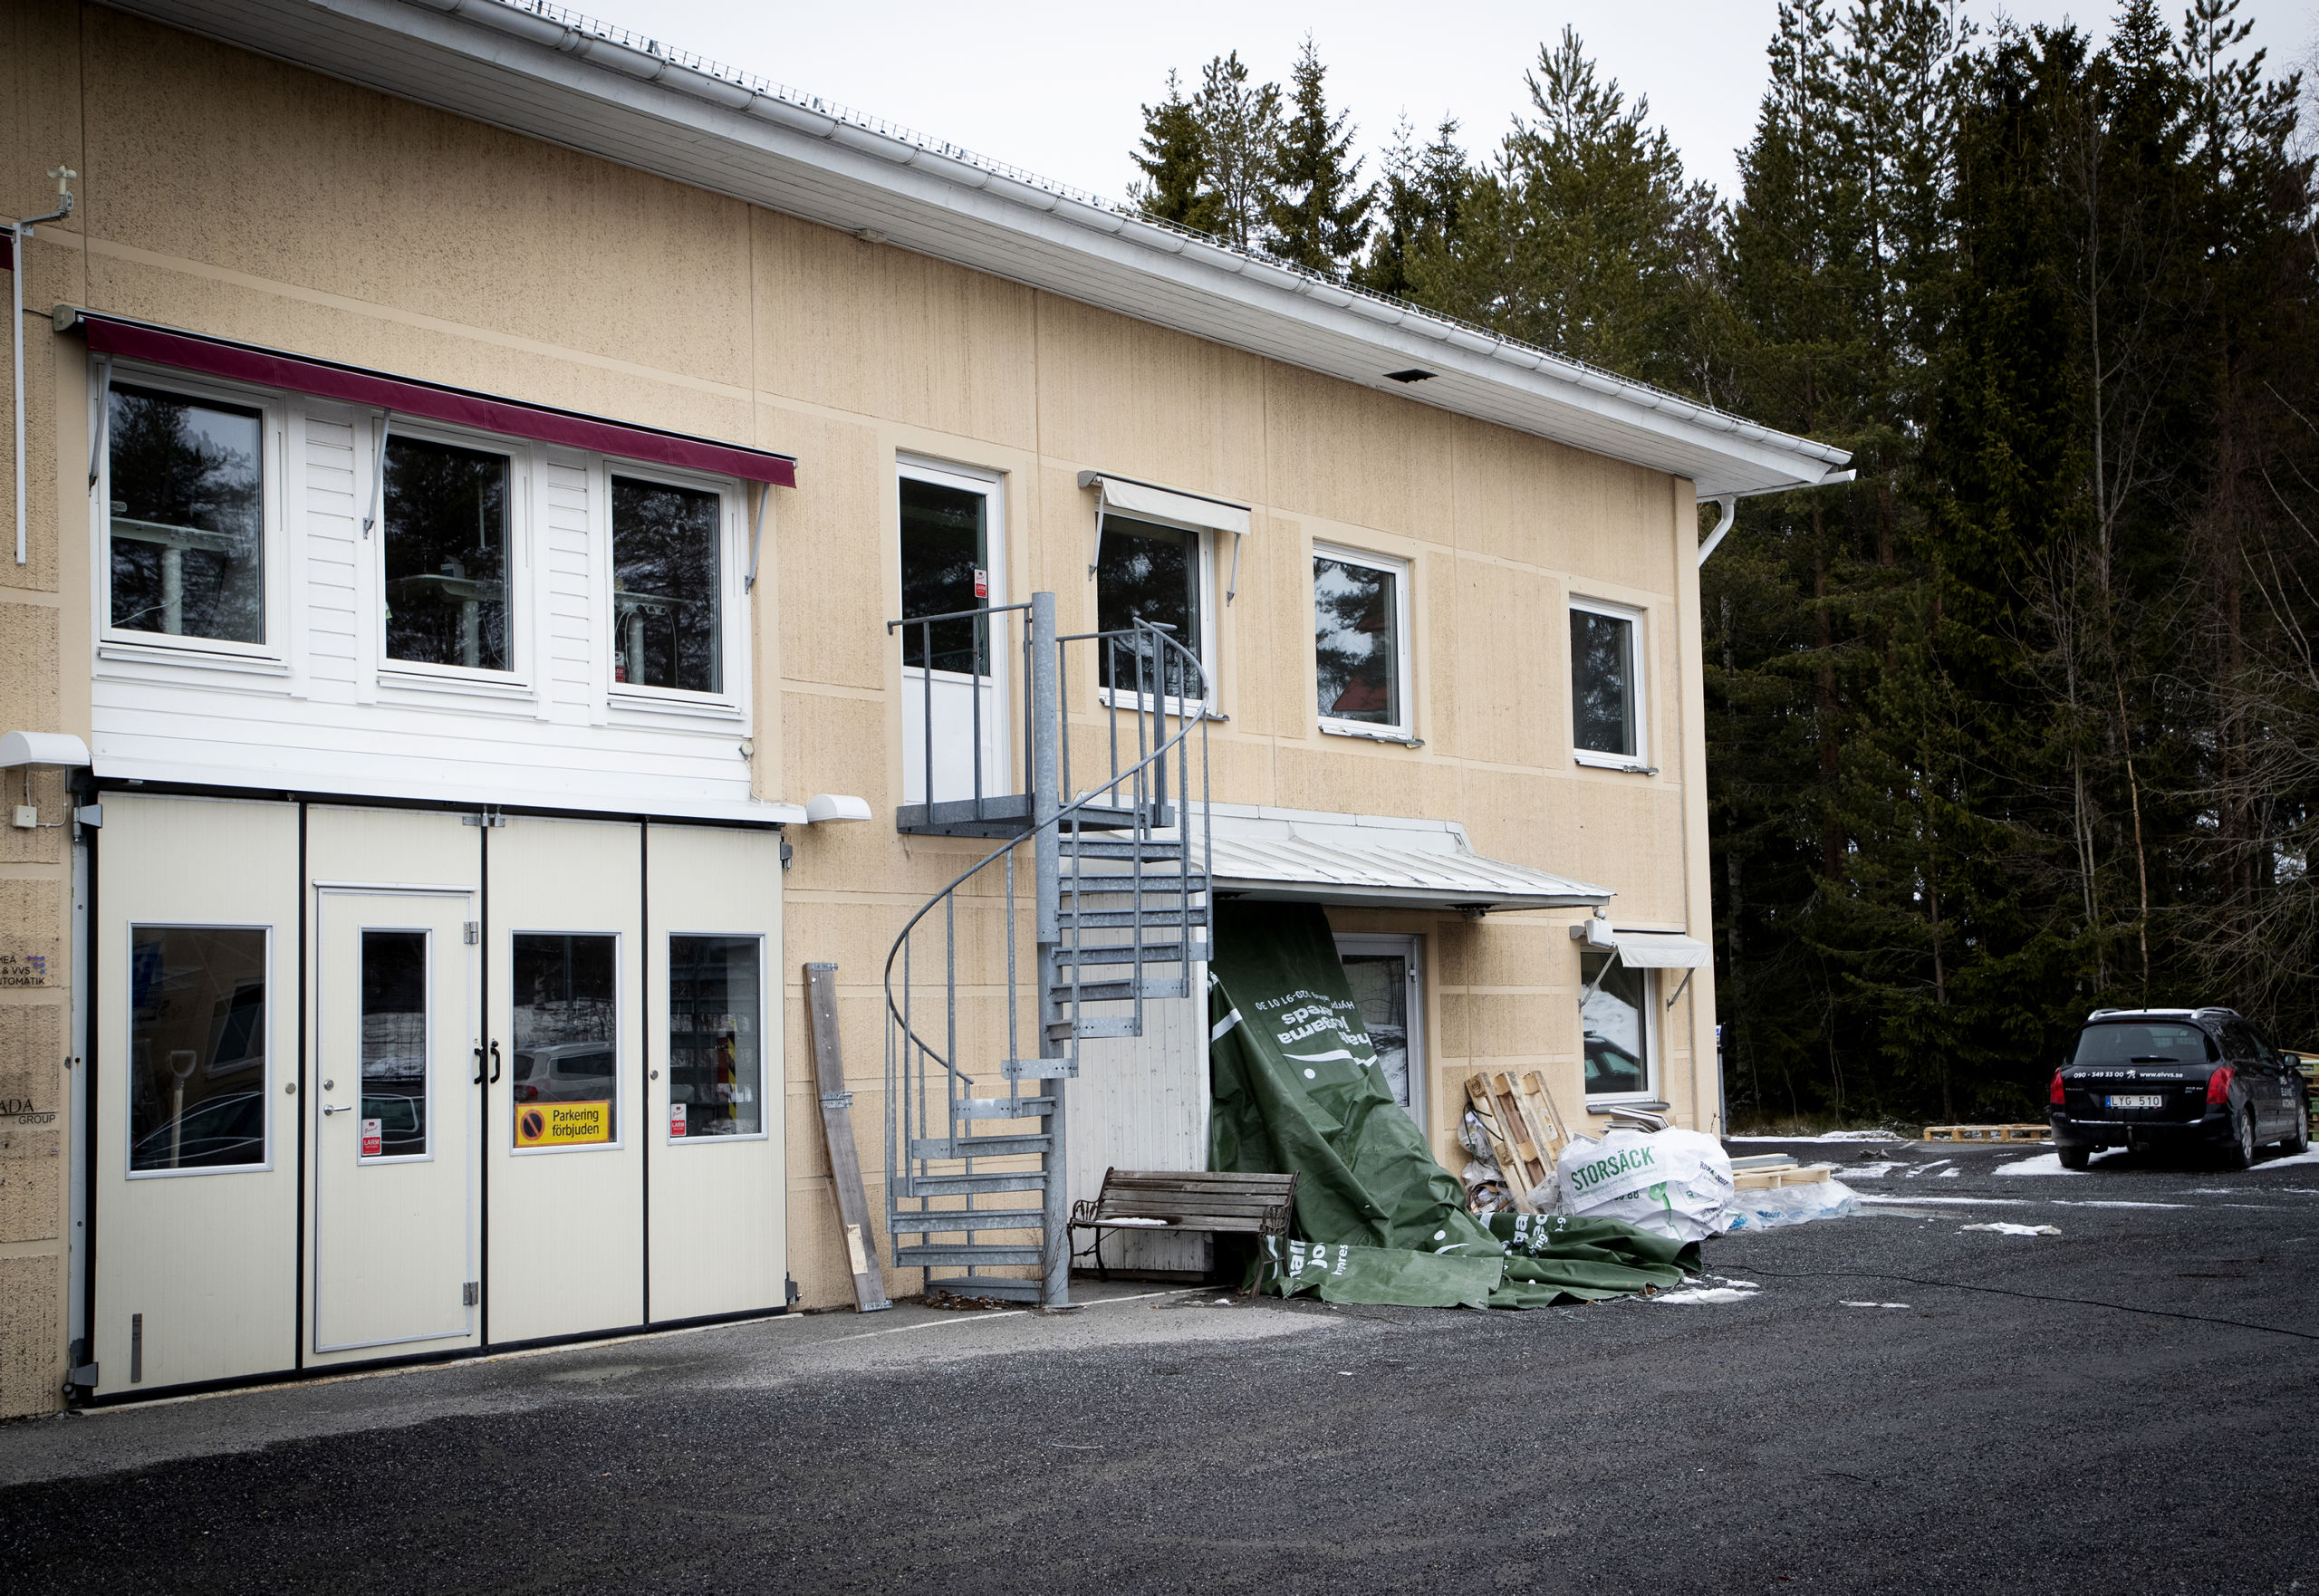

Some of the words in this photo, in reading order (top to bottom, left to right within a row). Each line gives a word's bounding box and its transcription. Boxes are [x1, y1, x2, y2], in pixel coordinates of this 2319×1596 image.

[2, 966, 9, 975] &
[12, 966, 31, 975] VVS
[0, 977, 45, 985] TOMATIK
[1255, 1001, 1267, 1010] 30
[1268, 998, 1281, 1008] 01
[2112, 1096, 2131, 1106] LYG
[2139, 1096, 2160, 1106] 510
[18, 1114, 56, 1125] GROUP
[553, 1109, 599, 1122] Parkering
[552, 1123, 600, 1138] förbjuden
[1571, 1147, 1655, 1191] STORSÄCK
